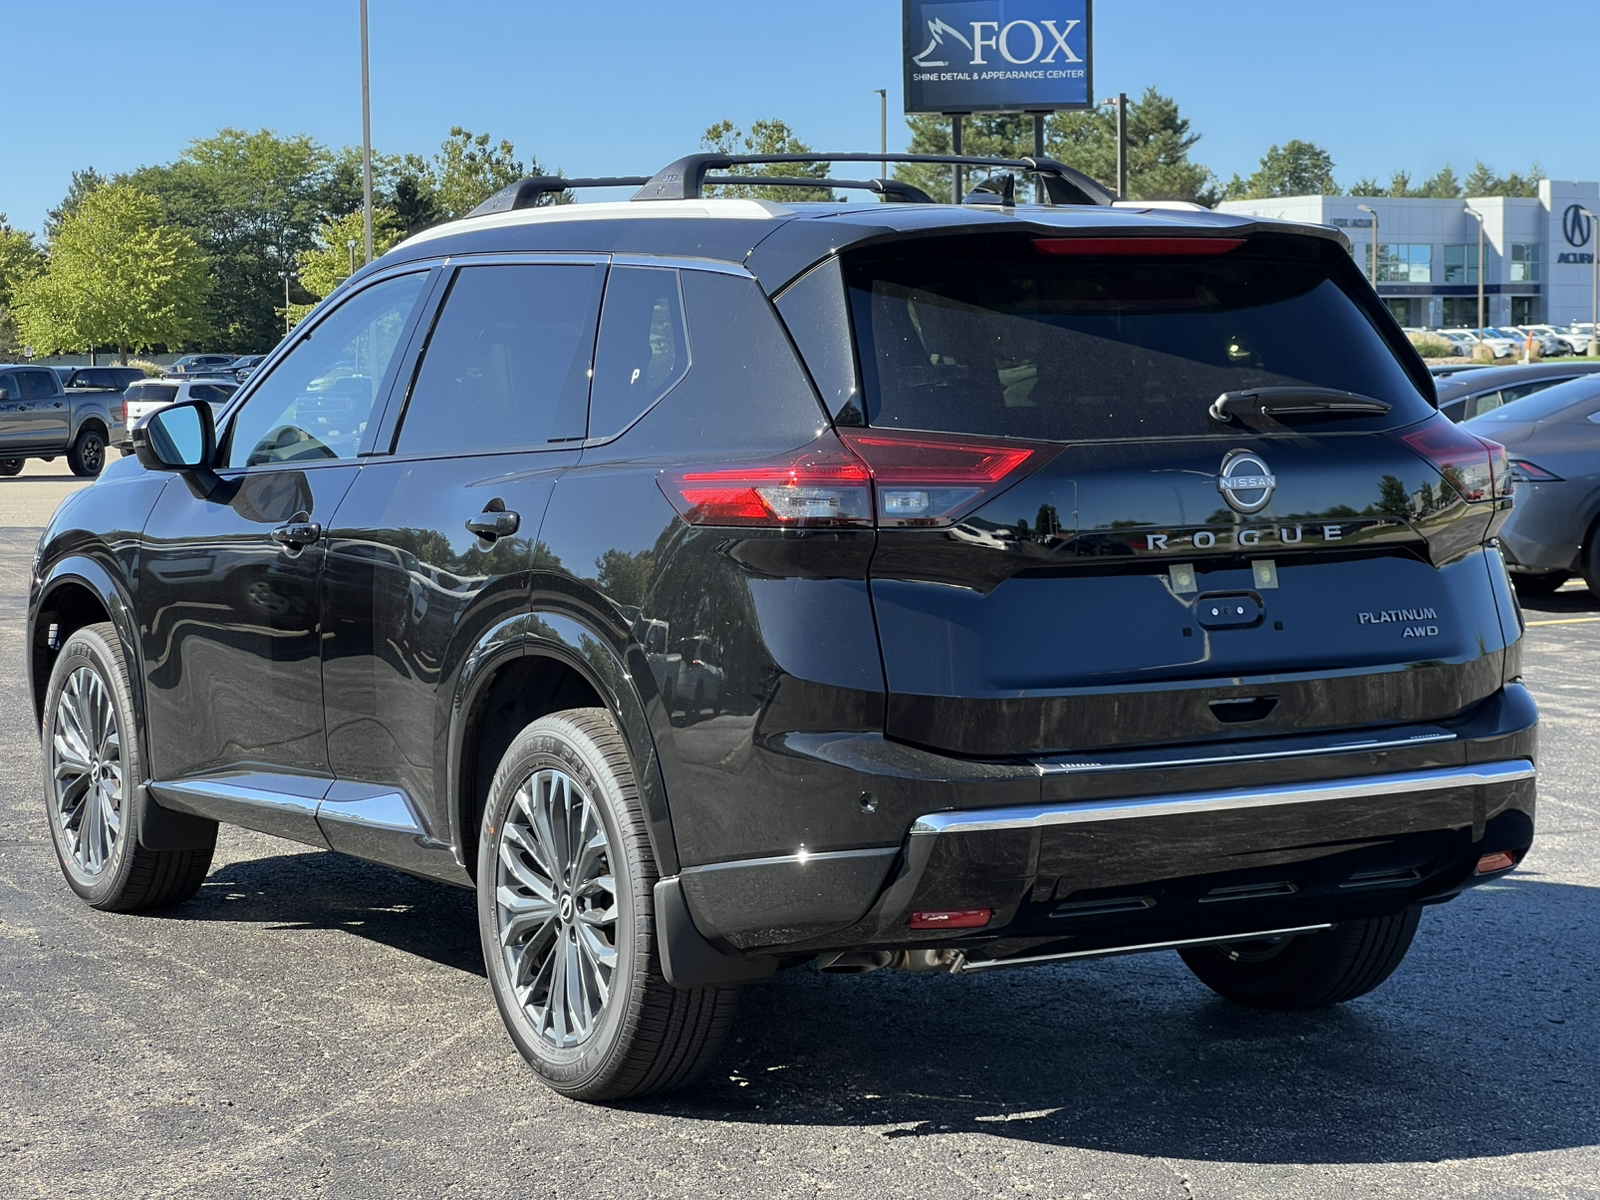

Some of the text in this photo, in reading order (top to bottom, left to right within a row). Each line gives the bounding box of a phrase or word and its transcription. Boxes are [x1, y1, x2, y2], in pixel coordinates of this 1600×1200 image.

[970, 19, 1083, 64] FOX
[913, 69, 1084, 81] SHINE DETAIL & APPEARANCE CENTER
[1221, 476, 1275, 488] NISSAN
[1146, 524, 1342, 550] ROGUE
[1358, 607, 1438, 624] PLATINUM
[1402, 625, 1439, 638] AWD
